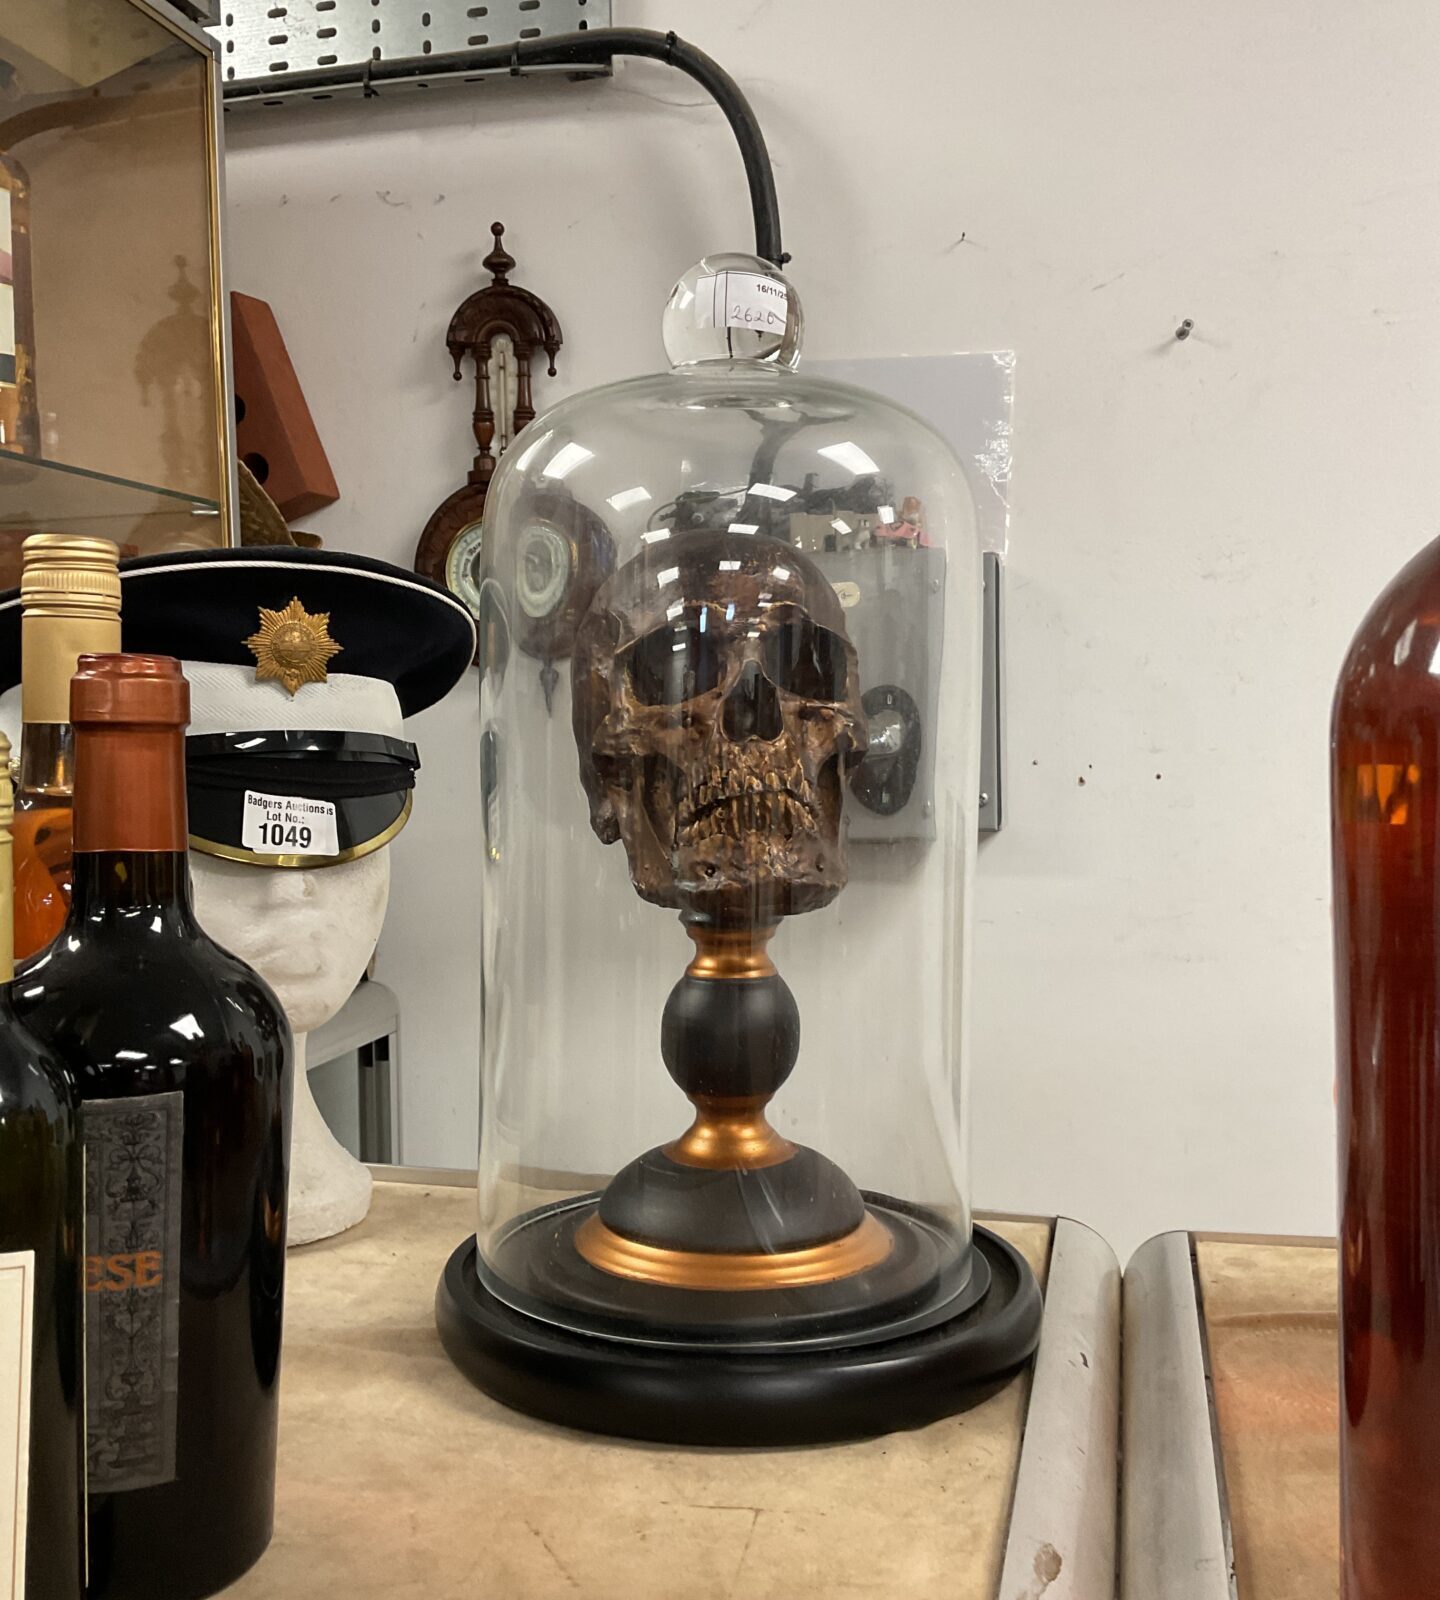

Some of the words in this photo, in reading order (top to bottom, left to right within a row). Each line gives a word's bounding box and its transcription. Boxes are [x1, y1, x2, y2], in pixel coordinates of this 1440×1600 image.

[248, 794, 282, 810] Badgers
[285, 801, 325, 814] Auctions
[266, 811, 281, 822] Lot
[258, 823, 312, 849] 1049
